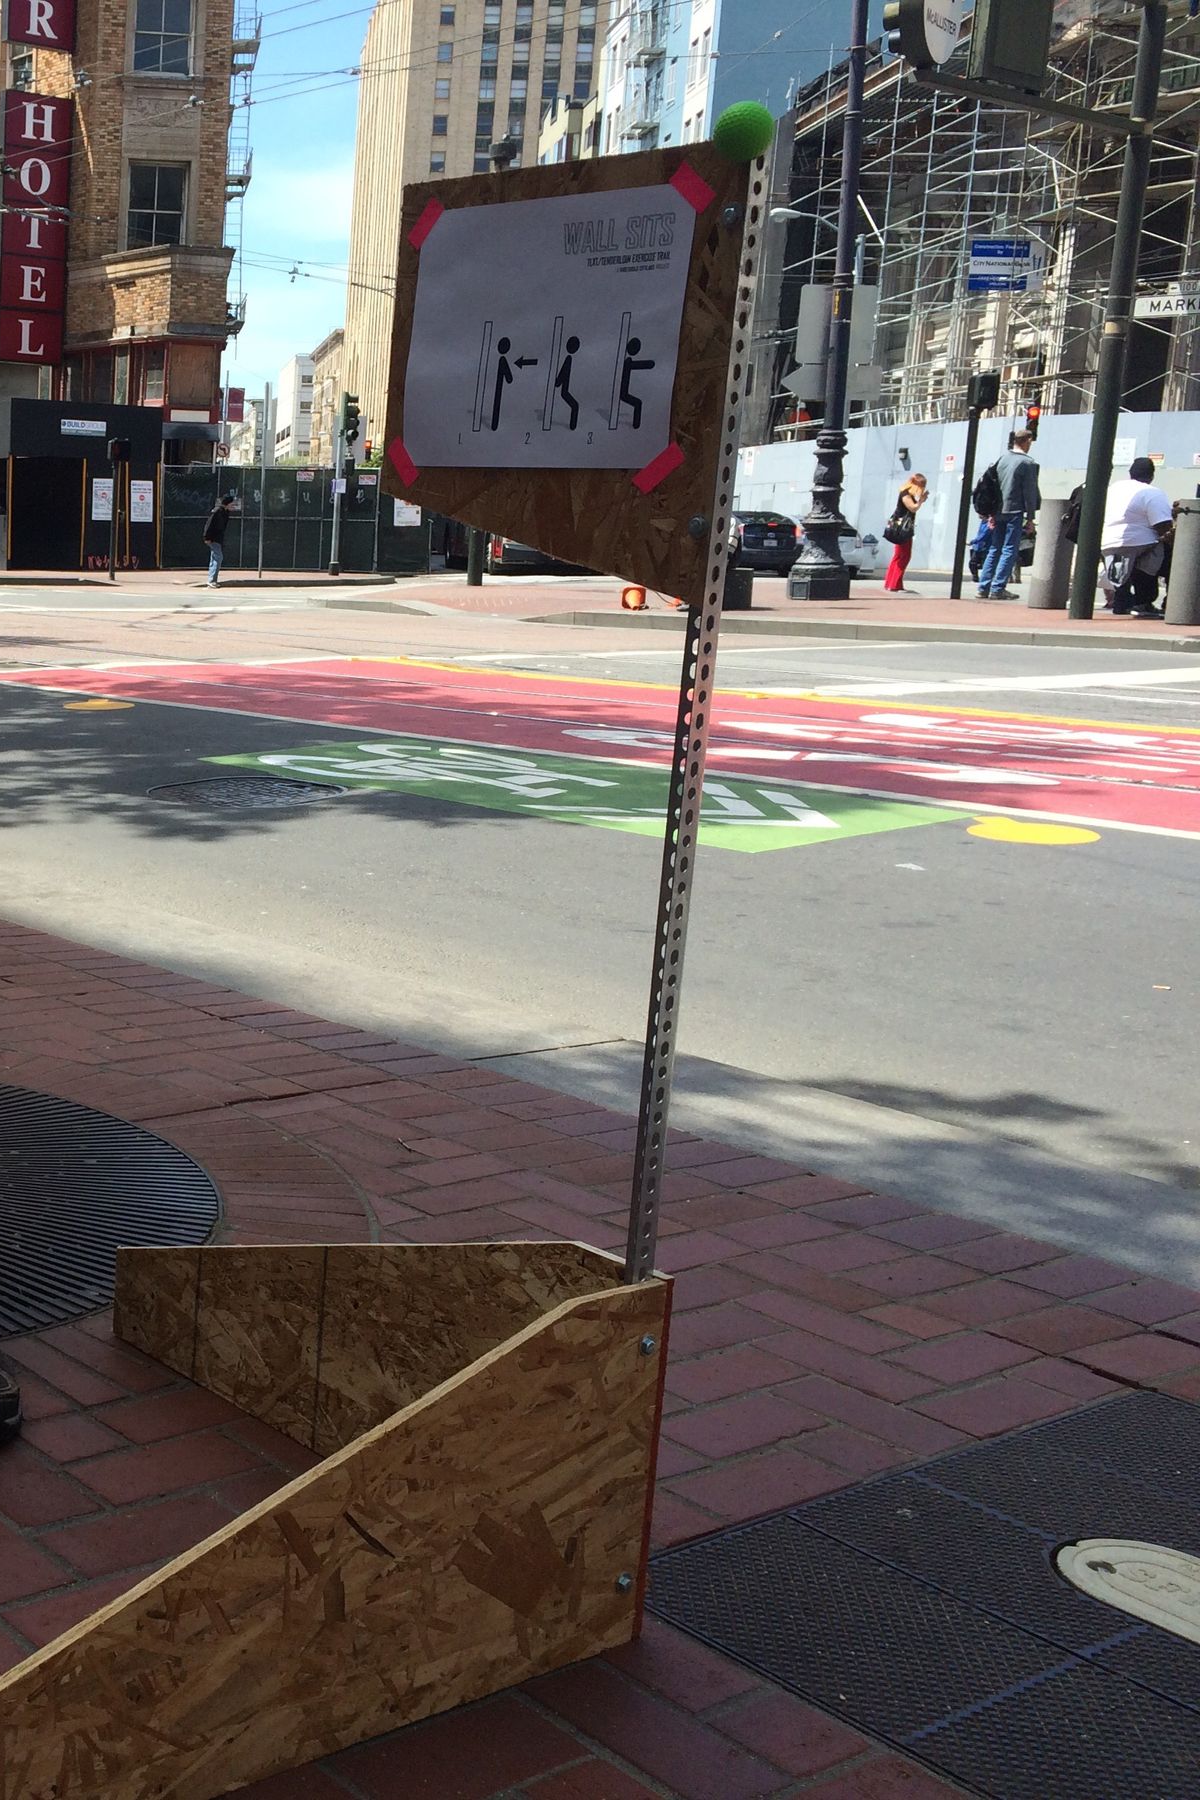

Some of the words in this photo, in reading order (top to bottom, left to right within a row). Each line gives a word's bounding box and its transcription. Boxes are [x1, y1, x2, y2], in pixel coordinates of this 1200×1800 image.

[927, 8, 957, 35] McALLISTER
[17, 101, 57, 356] HOTEL
[563, 218, 619, 255] WALL
[625, 212, 676, 250] SITS
[1150, 298, 1200, 312] MARK
[586, 432, 593, 445] 3
